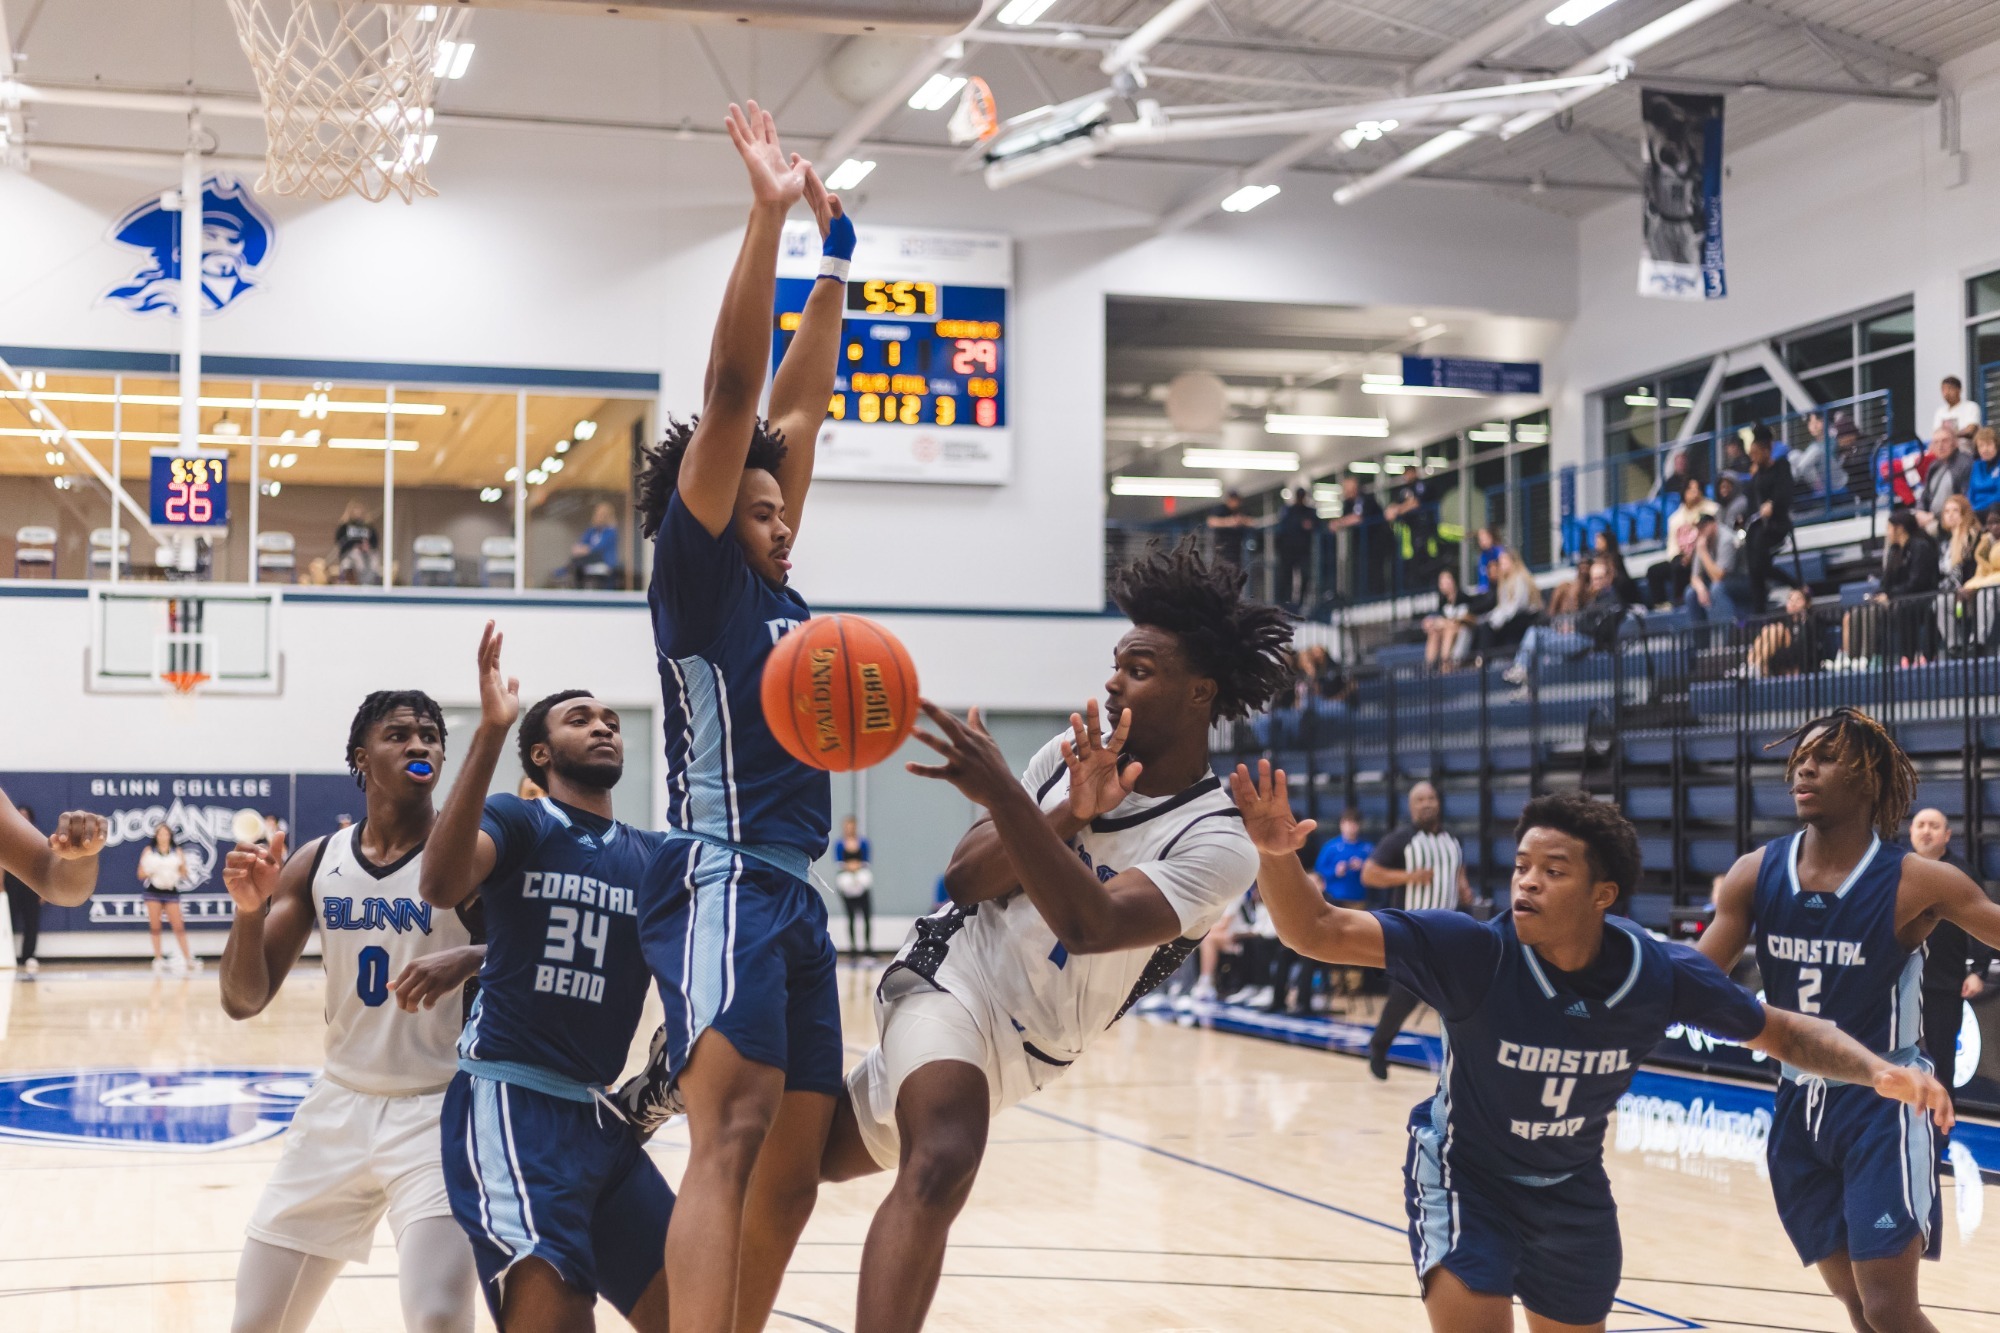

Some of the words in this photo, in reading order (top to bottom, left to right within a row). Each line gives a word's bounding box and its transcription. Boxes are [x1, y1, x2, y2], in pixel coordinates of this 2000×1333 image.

[864, 279, 937, 316] 5:57
[953, 339, 997, 374] 29
[171, 458, 223, 484] 5:57
[166, 482, 212, 522] 26
[811, 648, 843, 752] SPALDING
[90, 779, 160, 797] BLINN
[172, 779, 272, 798] COLLEGE
[522, 871, 638, 917] COASTAL
[323, 897, 433, 936] BLINN
[544, 905, 610, 969] 34
[1767, 933, 1866, 966] COASTAL
[356, 946, 390, 1007] 0
[534, 964, 606, 1004] BEND
[1798, 967, 1822, 1014] 2
[1497, 1039, 1632, 1075] COASTAL
[1541, 1077, 1578, 1118] 4
[1510, 1116, 1586, 1141] BEND
